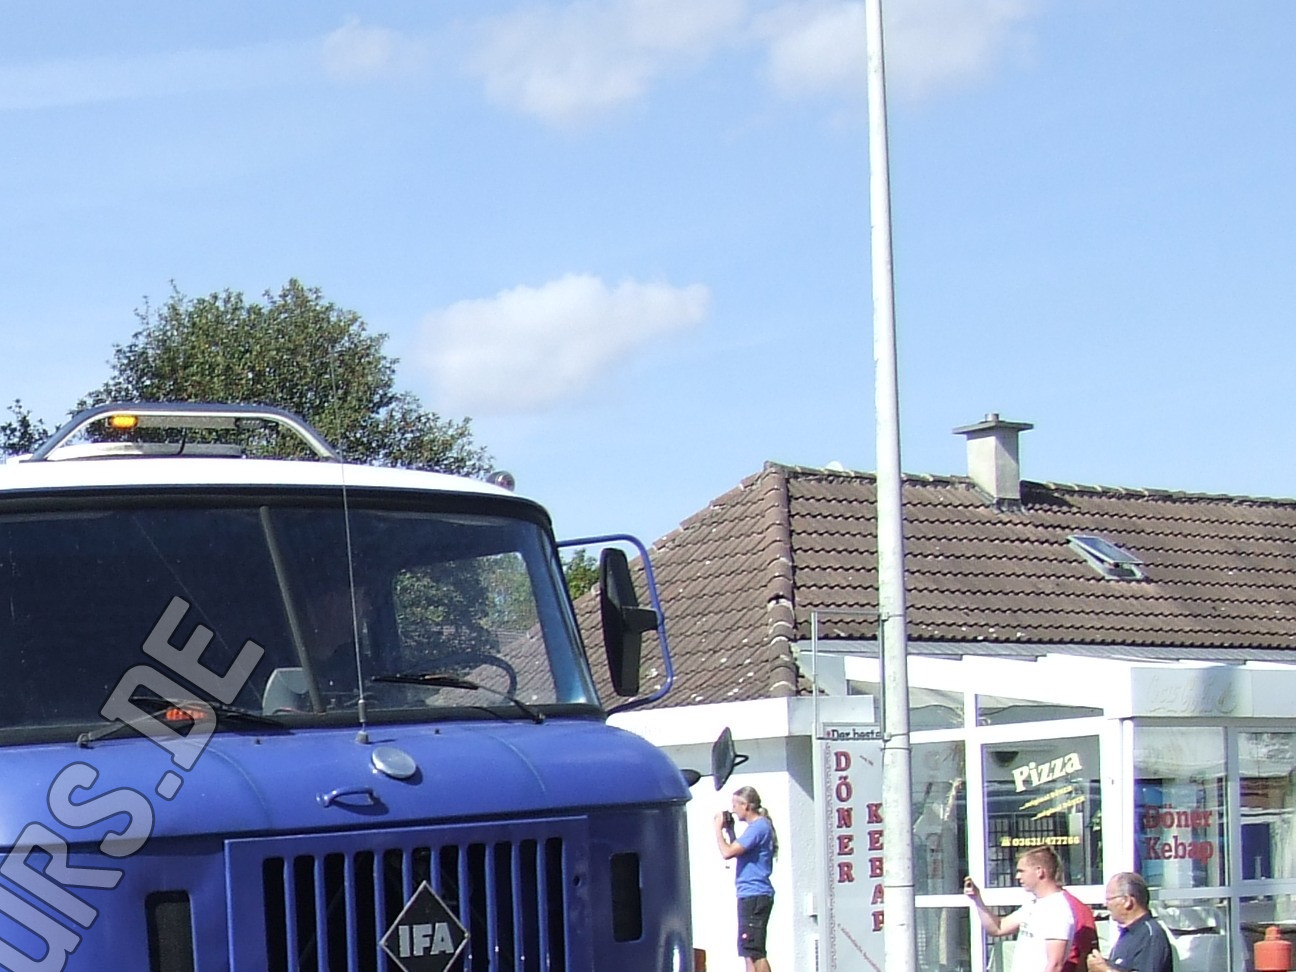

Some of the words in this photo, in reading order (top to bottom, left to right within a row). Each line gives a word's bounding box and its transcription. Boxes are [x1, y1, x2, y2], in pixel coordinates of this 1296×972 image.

[1012, 752, 1082, 793] Pizza
[834, 751, 854, 883] DÖNER
[1143, 804, 1212, 829] Döner
[1144, 835, 1214, 865] Kebap
[398, 922, 454, 958] IFA
